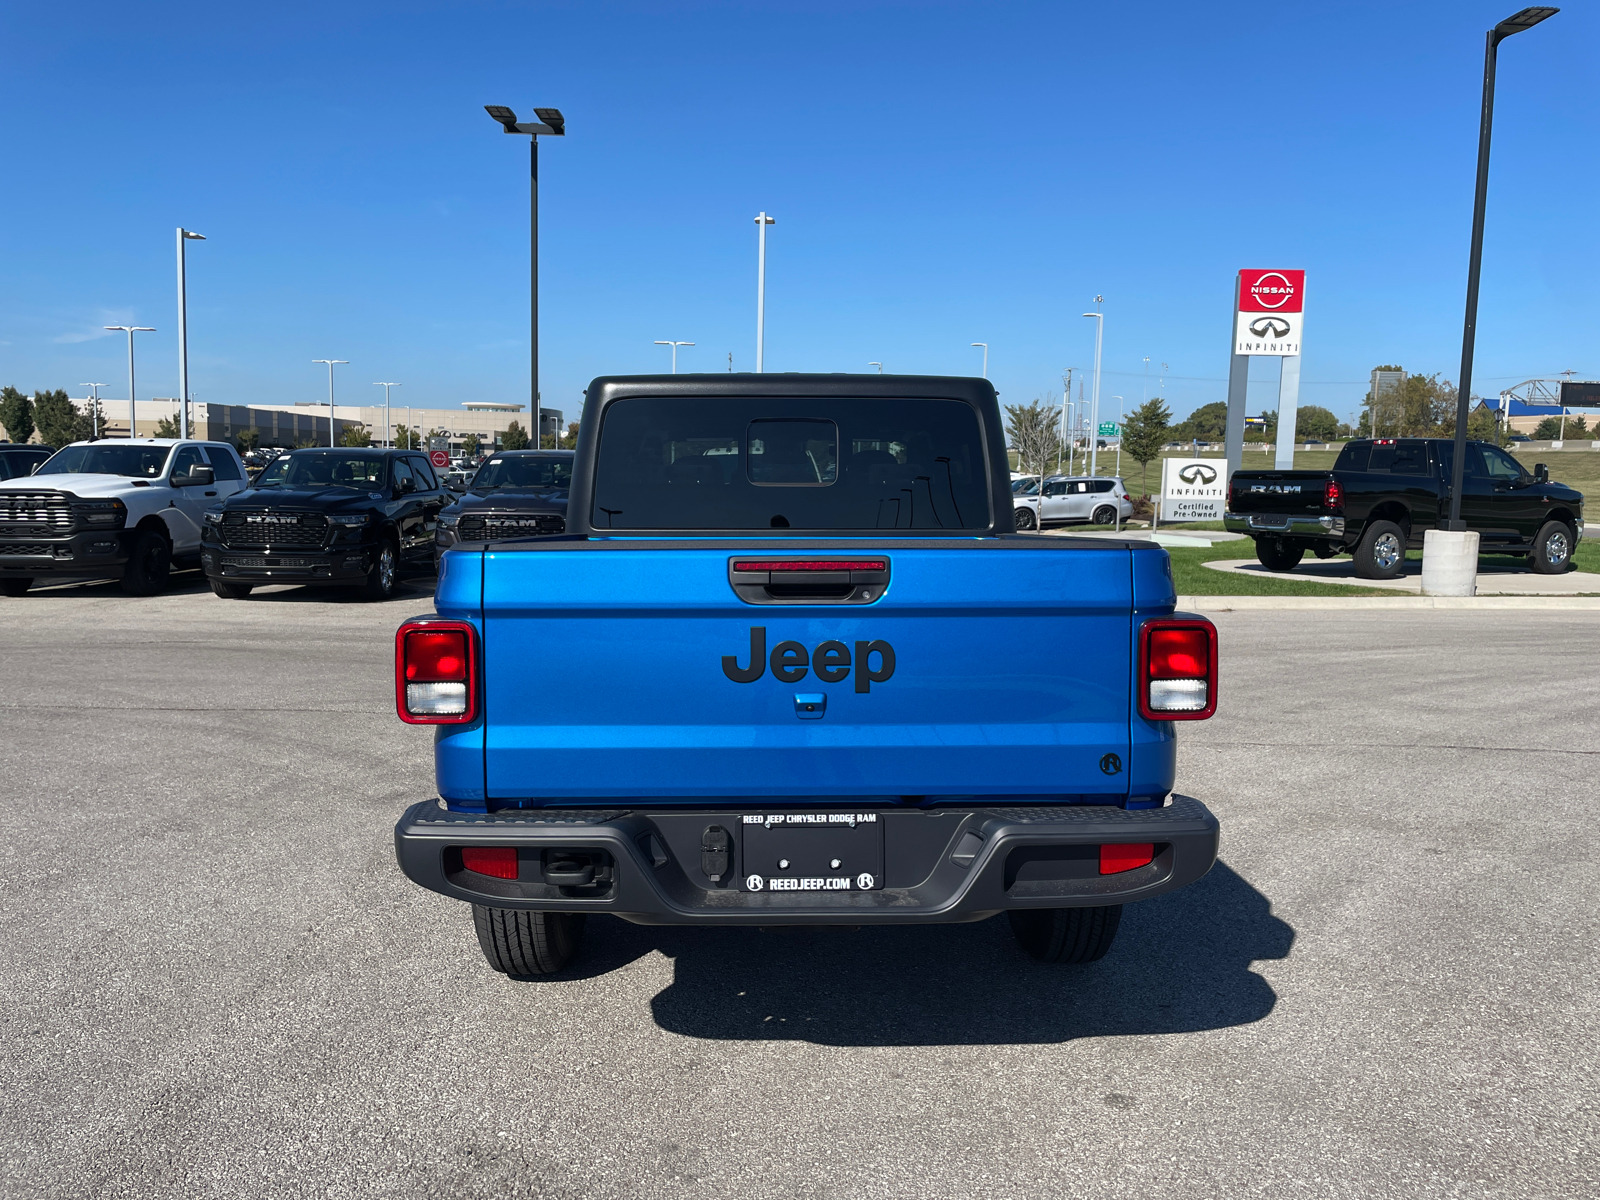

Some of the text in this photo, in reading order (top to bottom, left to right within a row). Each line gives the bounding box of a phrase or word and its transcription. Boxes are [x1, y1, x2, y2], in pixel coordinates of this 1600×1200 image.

[1239, 343, 1298, 351] INFINITI
[1250, 485, 1301, 494] RAM
[485, 519, 537, 527] RAM
[721, 626, 896, 693] Jeep
[743, 814, 876, 823] REED JEEP CHRYSLER DODGE RAM
[770, 878, 850, 890] REEDJEEP.COM
